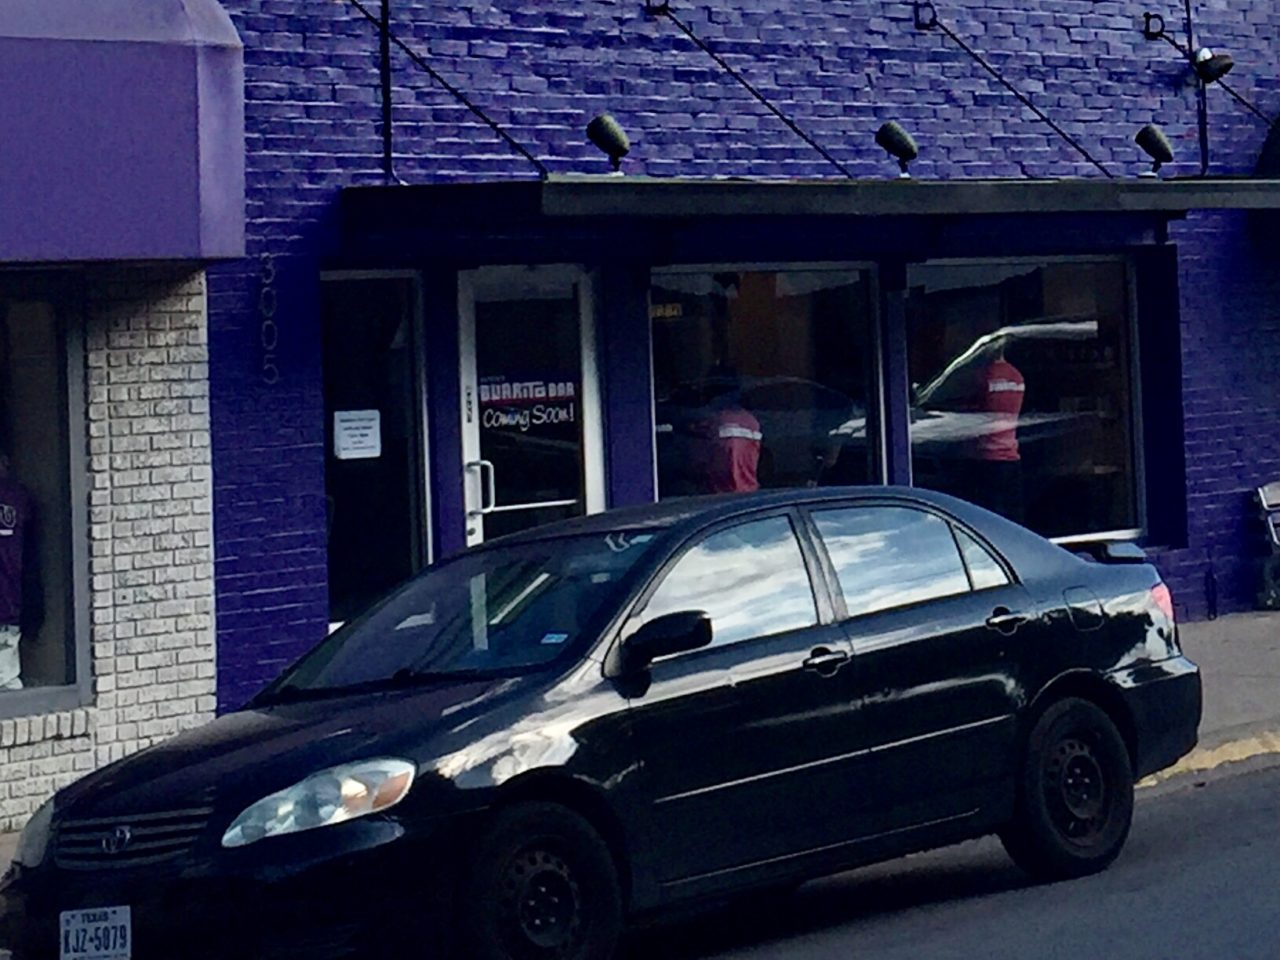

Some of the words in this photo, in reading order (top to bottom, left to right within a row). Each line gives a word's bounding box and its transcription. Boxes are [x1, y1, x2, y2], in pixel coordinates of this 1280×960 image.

[547, 382, 575, 399] BAR
[483, 409, 531, 432] Coming
[531, 401, 575, 425] Soon!
[80, 910, 110, 924] TEXAS
